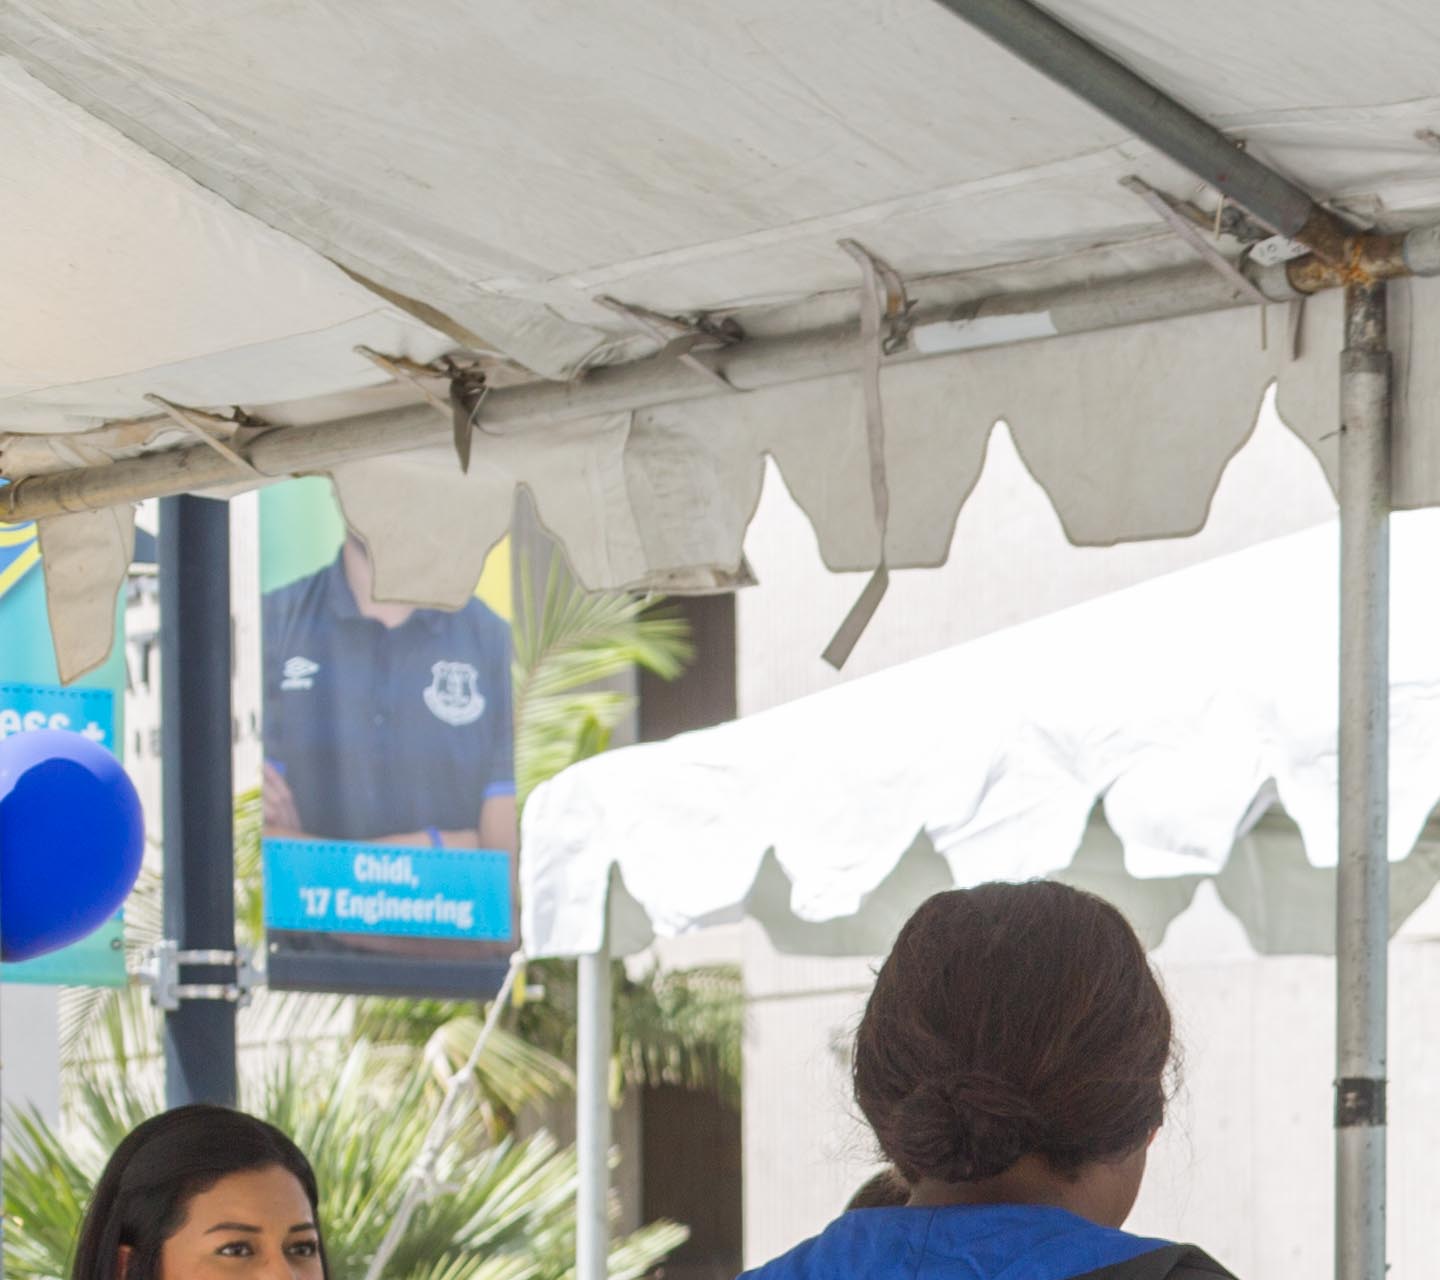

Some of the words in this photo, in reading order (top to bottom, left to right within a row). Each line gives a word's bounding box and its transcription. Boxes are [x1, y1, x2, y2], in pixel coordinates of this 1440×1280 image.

[353, 852, 420, 890] Chidi,
[299, 884, 331, 917] '17
[334, 886, 474, 930] Engineering
